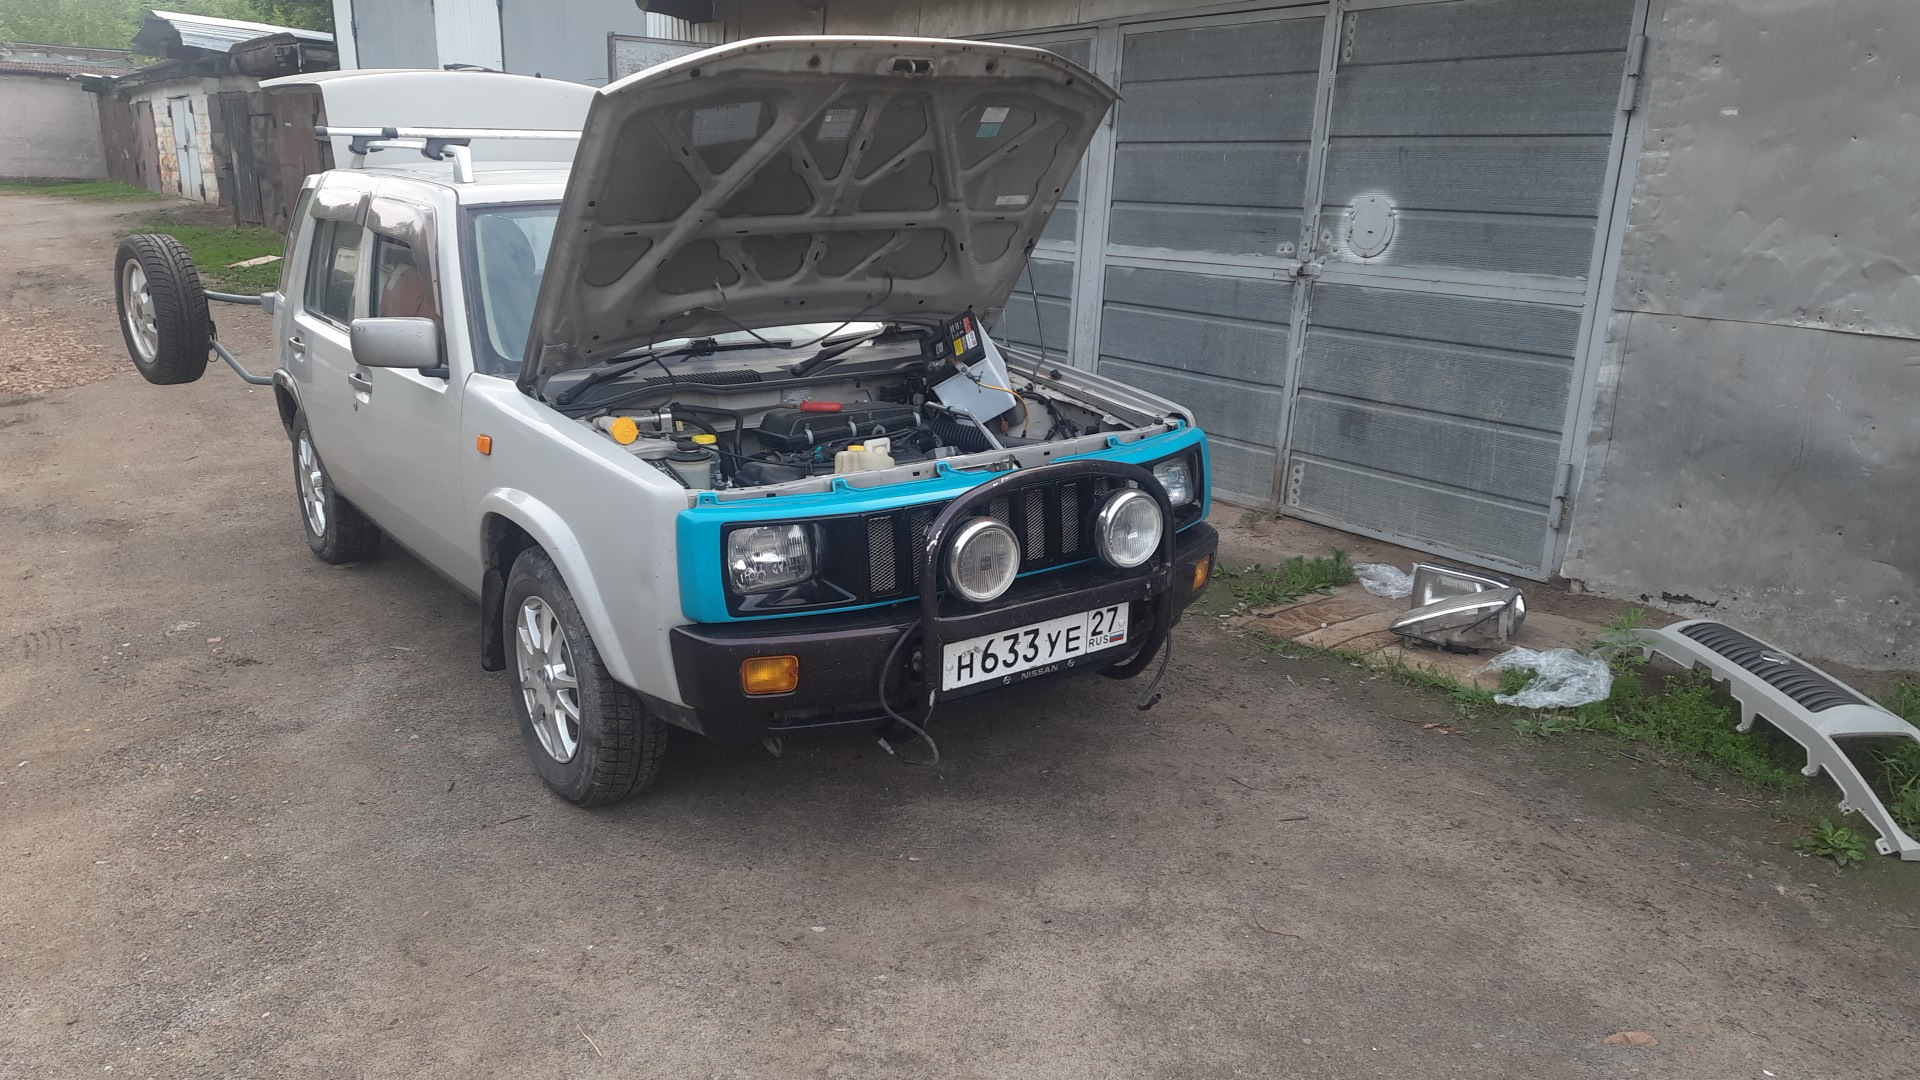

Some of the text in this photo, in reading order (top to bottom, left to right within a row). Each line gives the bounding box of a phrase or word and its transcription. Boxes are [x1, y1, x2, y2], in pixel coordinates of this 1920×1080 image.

[1091, 606, 1119, 637] 27
[1088, 634, 1109, 648] RUS
[1021, 664, 1059, 680] NISSAN
